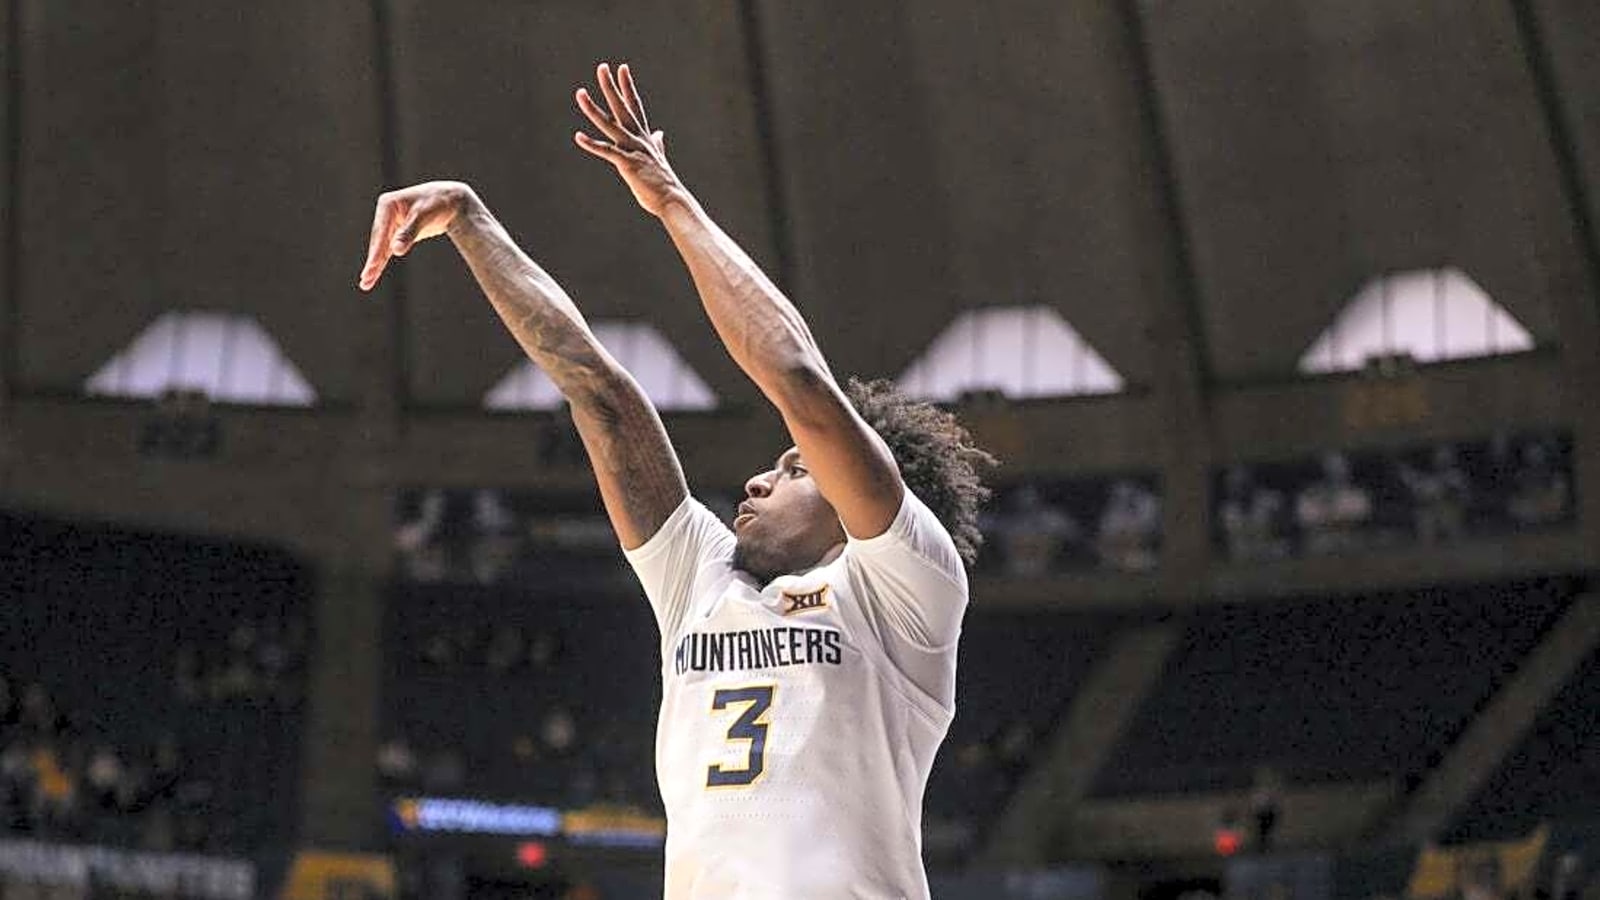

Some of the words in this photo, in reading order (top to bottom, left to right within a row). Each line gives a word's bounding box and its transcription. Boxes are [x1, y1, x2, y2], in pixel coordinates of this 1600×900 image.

[782, 584, 829, 615] XII
[675, 627, 842, 676] MOUNTAINEERS
[705, 684, 777, 790] 3
